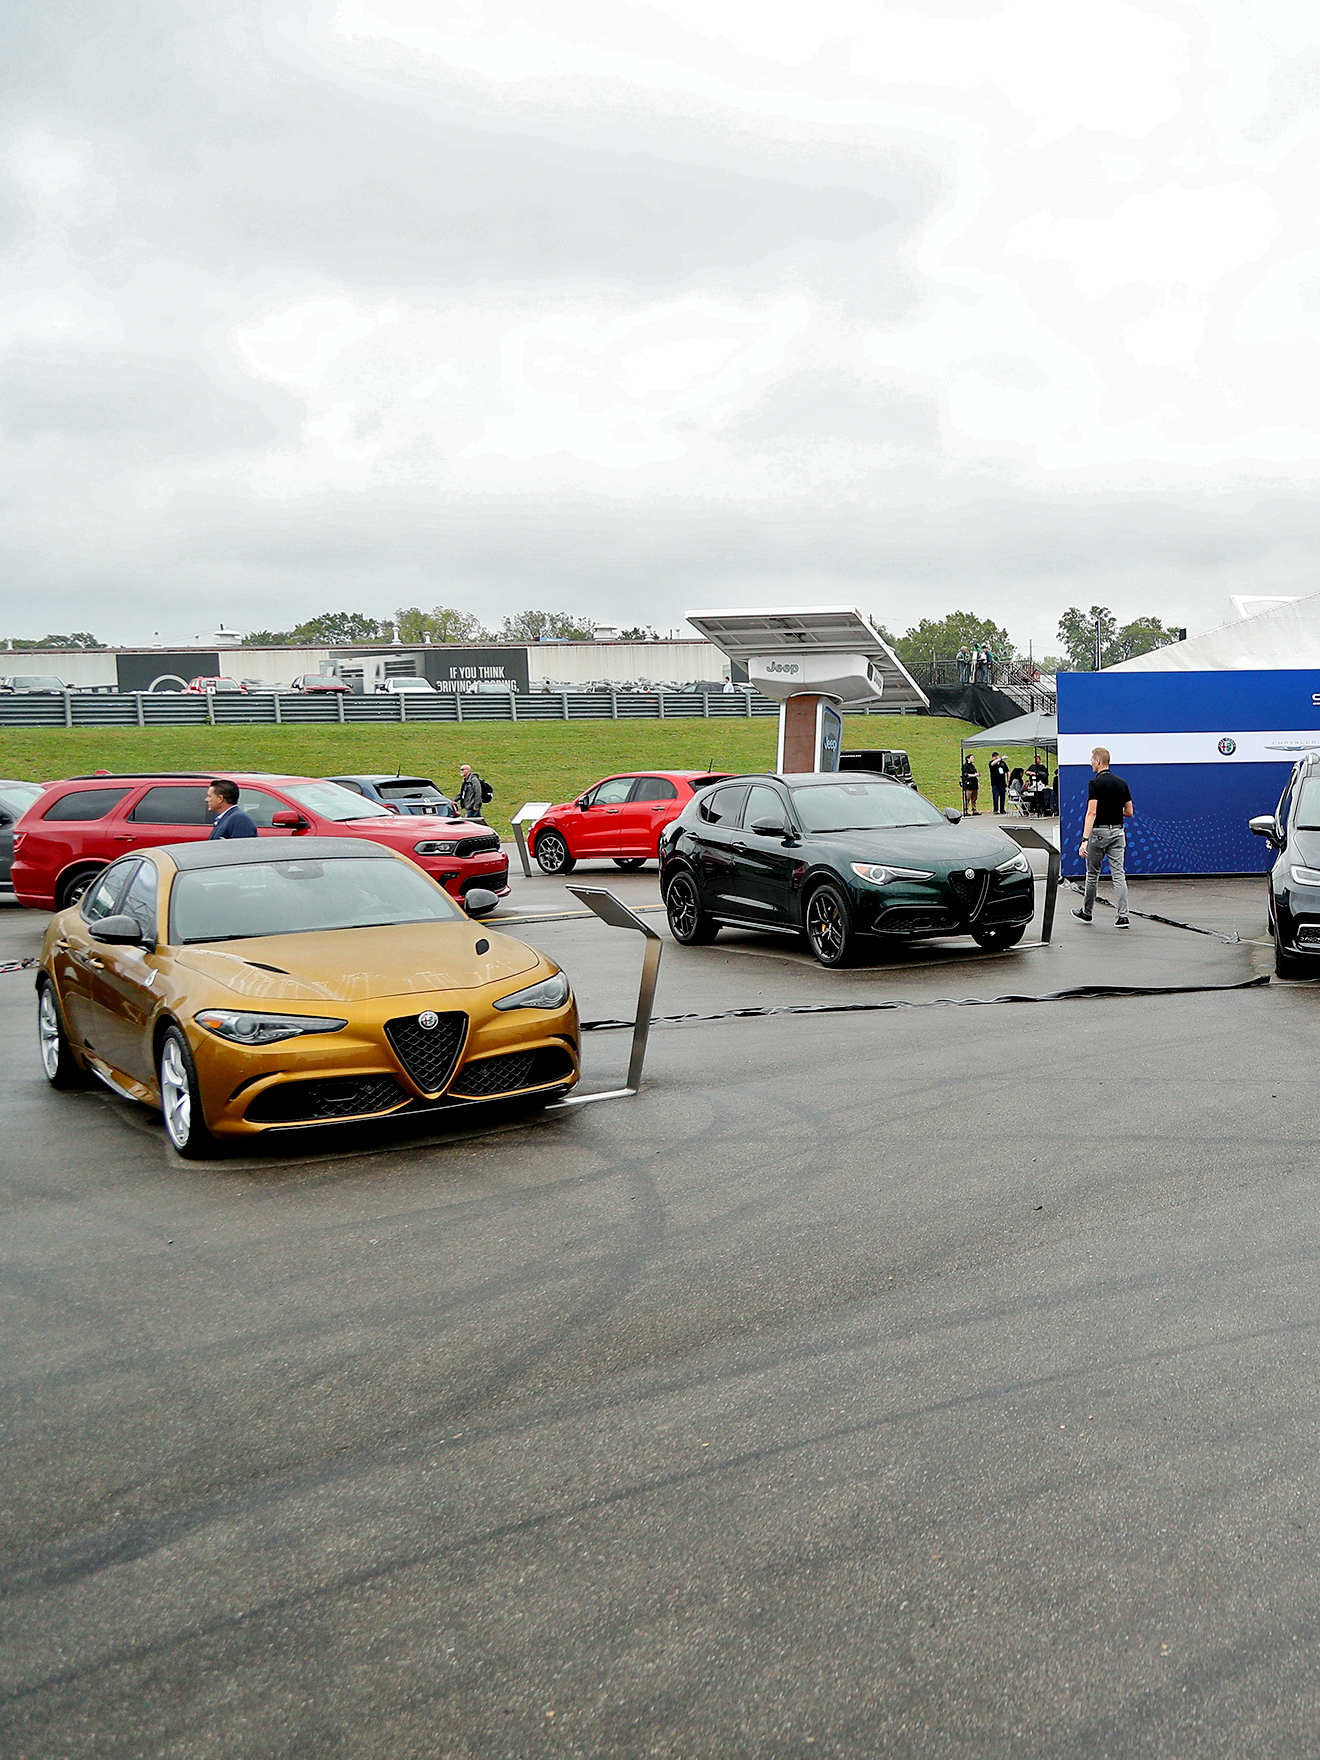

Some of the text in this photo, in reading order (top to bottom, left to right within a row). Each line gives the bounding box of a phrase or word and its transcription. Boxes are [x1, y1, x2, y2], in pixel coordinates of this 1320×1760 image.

[449, 666, 505, 679] IF YOU THINK
[766, 661, 800, 675] Jeep
[823, 736, 838, 752] Jeep
